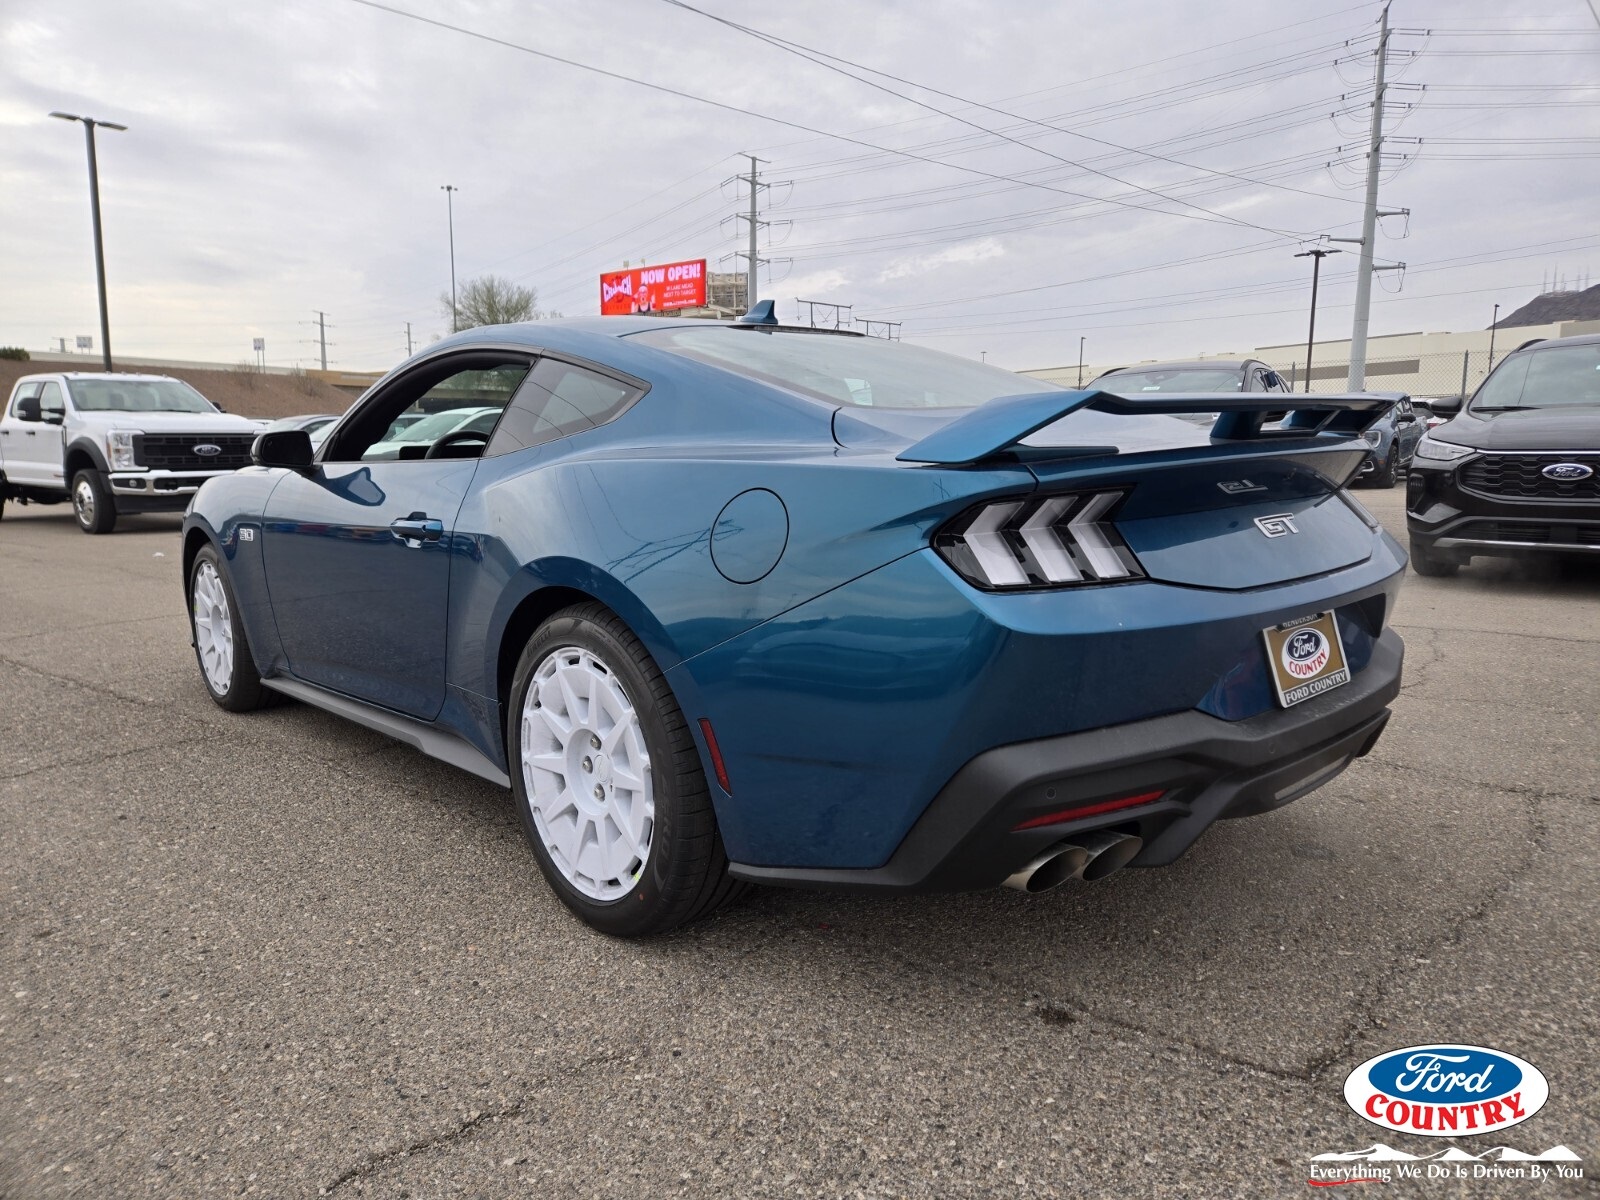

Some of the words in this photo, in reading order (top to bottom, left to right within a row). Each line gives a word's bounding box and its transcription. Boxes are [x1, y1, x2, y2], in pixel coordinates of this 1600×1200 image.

[641, 268, 665, 285] NOW
[667, 263, 700, 281] OPEN!
[603, 274, 632, 302] CRUNCH
[1553, 467, 1581, 477] Ford
[1254, 513, 1299, 538] GT
[1292, 634, 1316, 658] Ford
[1289, 649, 1327, 676] COUNTRY
[1285, 686, 1309, 704] FORD
[1309, 671, 1346, 693] COUNTRY
